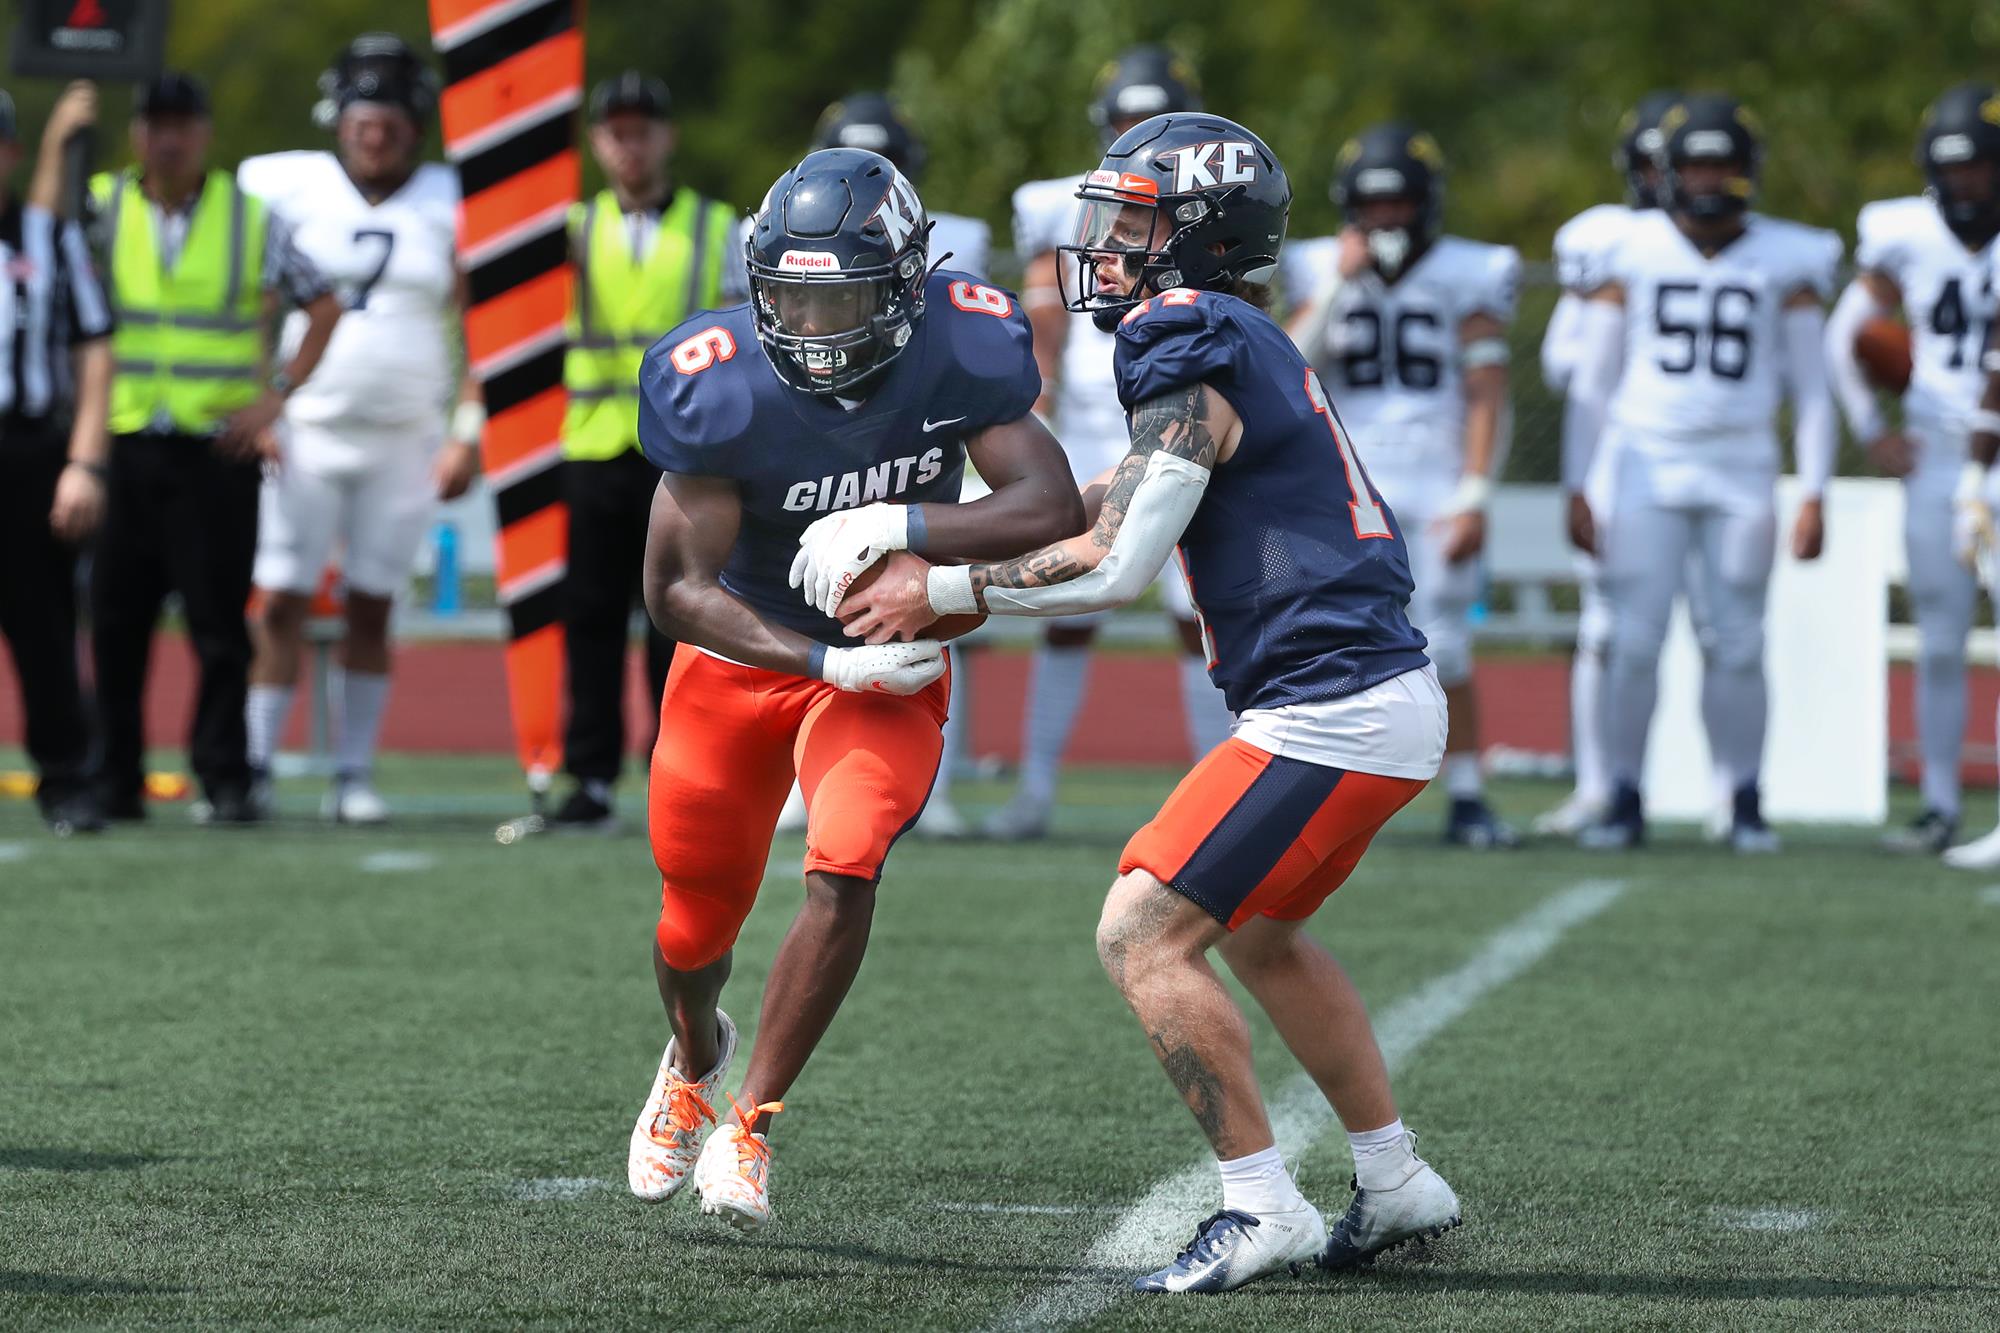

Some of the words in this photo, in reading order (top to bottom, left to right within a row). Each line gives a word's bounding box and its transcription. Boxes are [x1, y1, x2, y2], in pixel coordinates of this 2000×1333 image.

[1165, 142, 1256, 194] KC
[350, 230, 394, 310] 7
[785, 254, 831, 268] Riddell
[947, 280, 1013, 319] 6
[669, 325, 738, 377] 6
[1344, 309, 1441, 390] 26
[1655, 283, 1756, 381] 56
[782, 446, 943, 512] GIANTS
